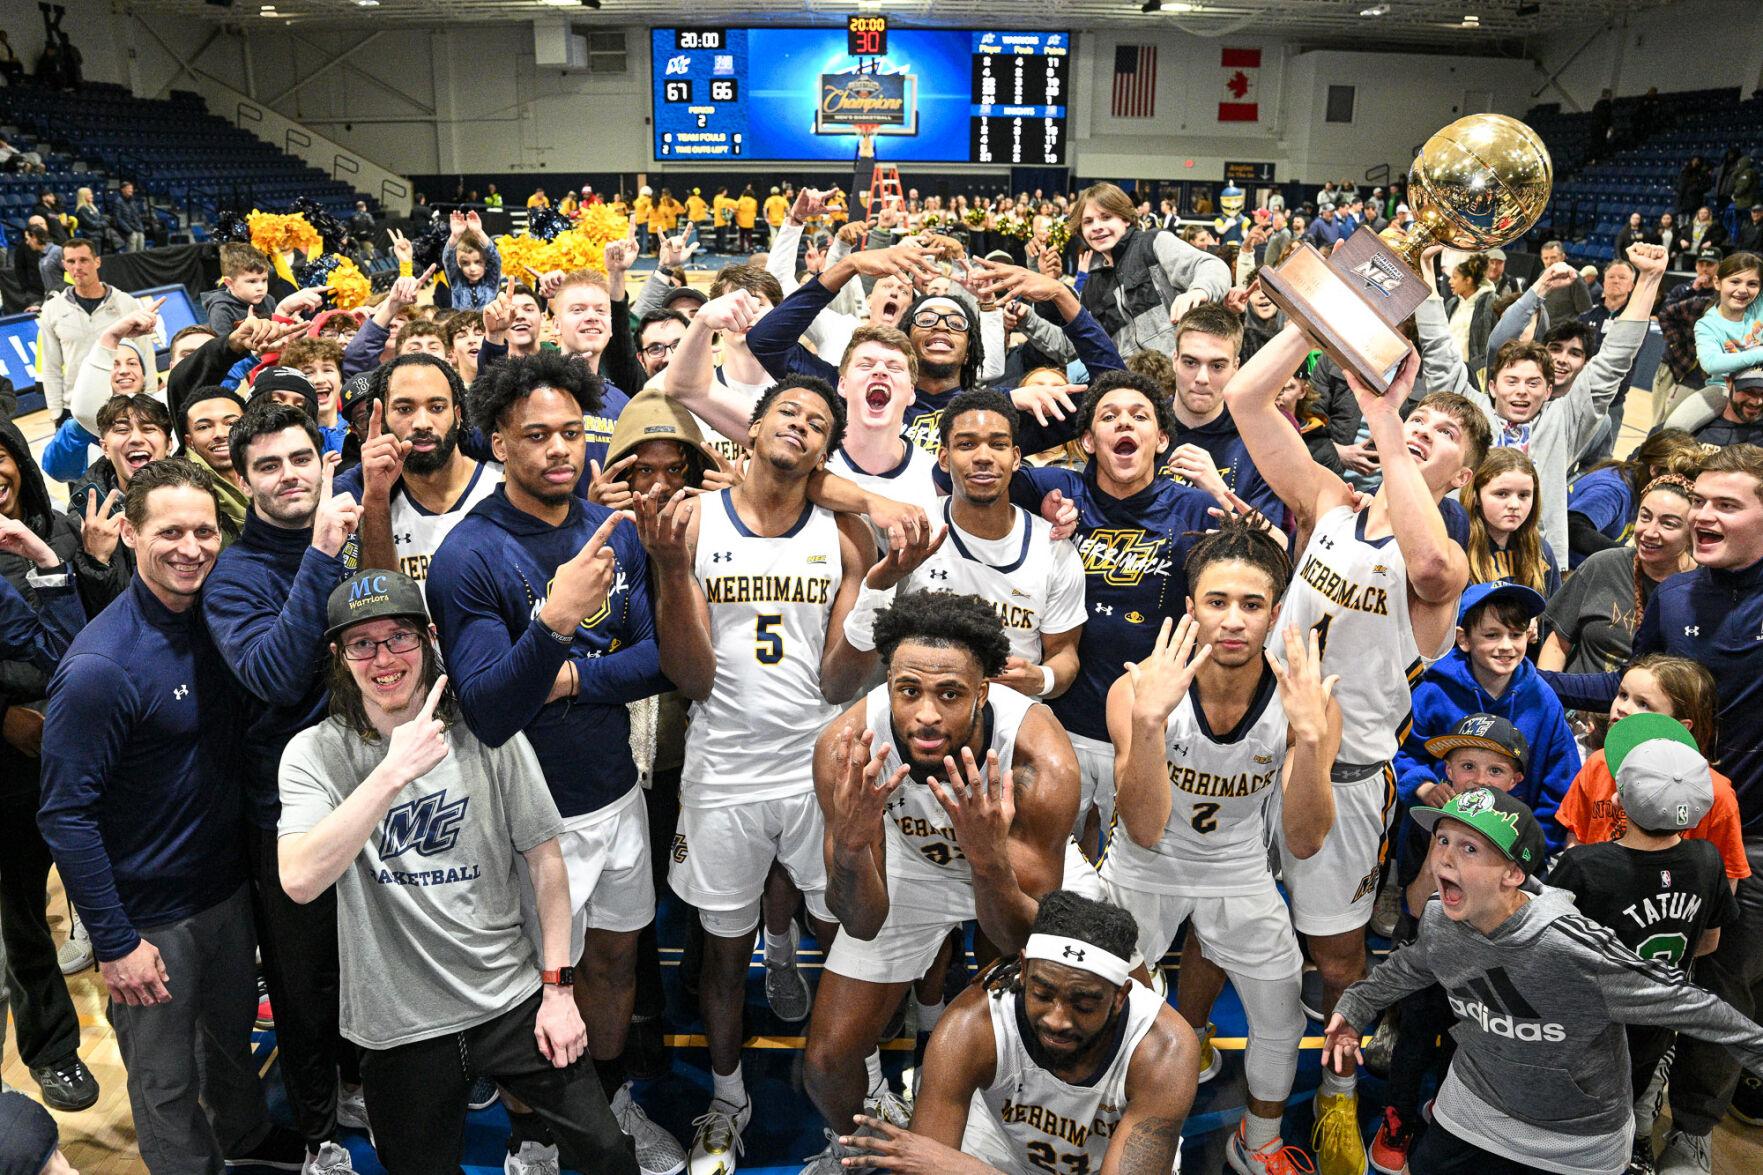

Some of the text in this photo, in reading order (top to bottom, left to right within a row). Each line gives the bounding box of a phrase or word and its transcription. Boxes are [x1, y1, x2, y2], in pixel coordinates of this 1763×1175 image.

[849, 18, 885, 32] 20:00
[681, 32, 719, 48] 20:00
[857, 31, 880, 53] 30
[667, 83, 687, 101] 67
[712, 82, 733, 100] 66
[823, 85, 903, 113] Champions
[697, 114, 707, 128] 2
[677, 133, 699, 142] TEAM
[699, 133, 726, 142] FOULS
[348, 576, 388, 602] MC
[705, 576, 831, 604] MERRIMACK
[1299, 553, 1388, 616] MERRMACK
[349, 594, 389, 609] Warriors
[755, 613, 784, 666] 5
[379, 788, 470, 862] MC
[1191, 802, 1221, 835] 2
[369, 864, 481, 887] AKETBALL
[1622, 892, 1702, 928] TATUM
[1447, 995, 1566, 1041] adidas
[1001, 1098, 1119, 1148] MERRIMC
